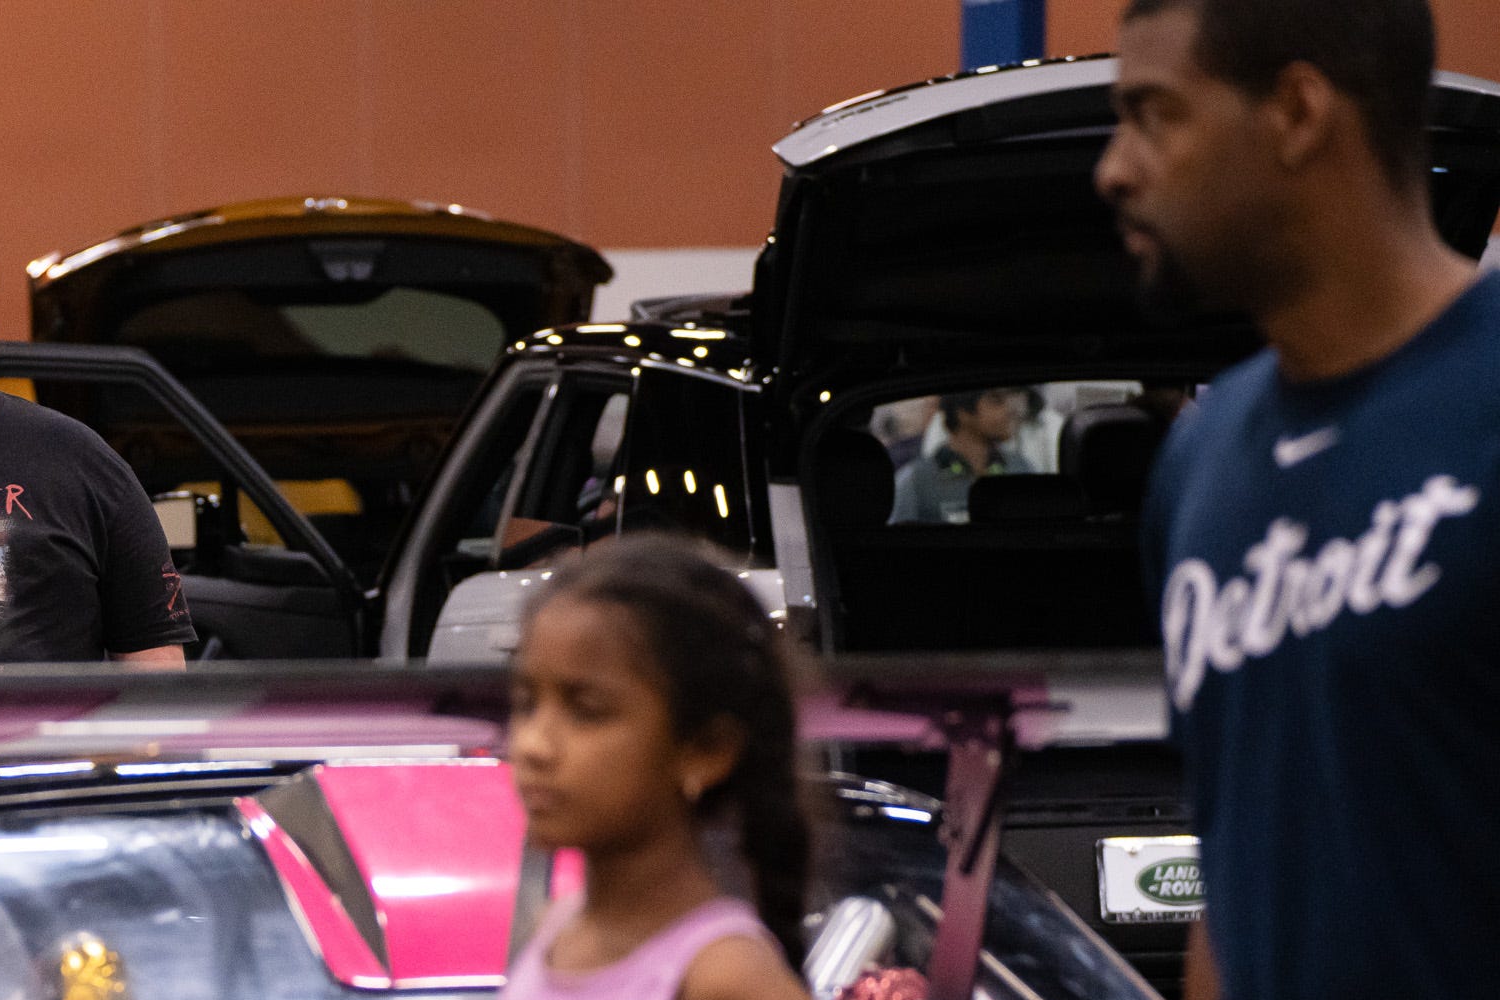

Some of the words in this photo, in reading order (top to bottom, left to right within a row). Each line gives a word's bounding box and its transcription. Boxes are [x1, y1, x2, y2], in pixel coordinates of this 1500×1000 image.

[1160, 475, 1480, 714] Detroit
[1154, 865, 1200, 881] LAND
[1160, 880, 1207, 896] ROVE
